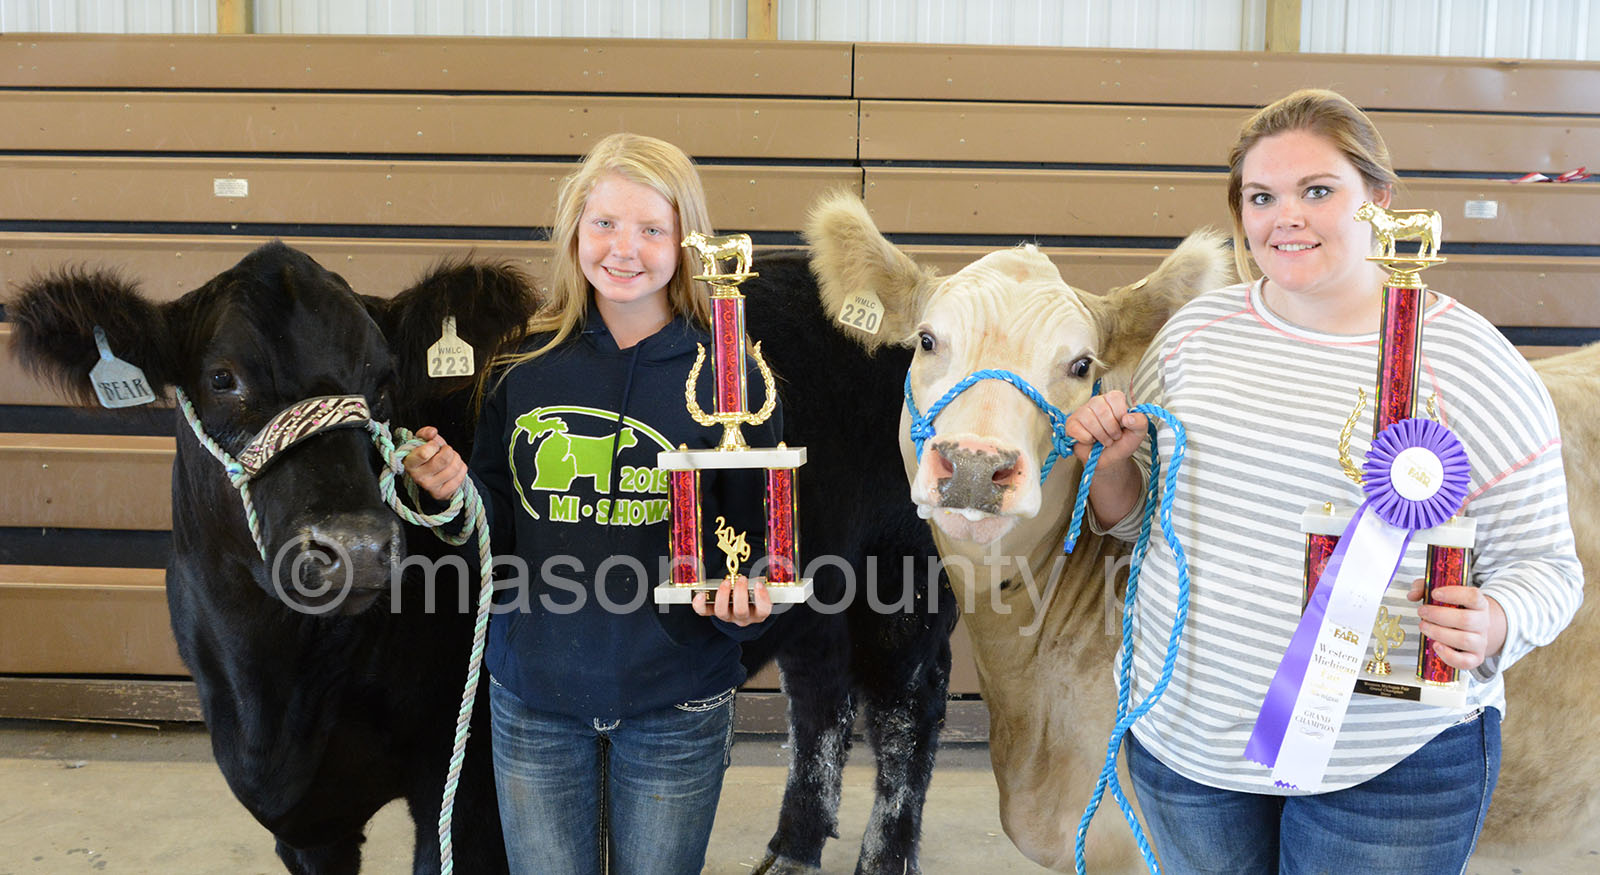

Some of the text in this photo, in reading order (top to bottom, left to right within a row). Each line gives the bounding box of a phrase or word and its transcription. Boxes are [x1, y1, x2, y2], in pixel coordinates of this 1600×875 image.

[855, 295, 877, 310] WMLC
[841, 303, 878, 331] 220
[439, 346, 462, 355] WMLC
[432, 356, 470, 376] 223
[99, 378, 149, 401] BEAR
[596, 498, 669, 527] SHOW
[1333, 628, 1359, 645] FAIR
[1319, 642, 1359, 664] Western
[1314, 653, 1357, 675] Michigan
[1295, 715, 1336, 733] CHAMPION
[1303, 710, 1331, 723] GRAND
